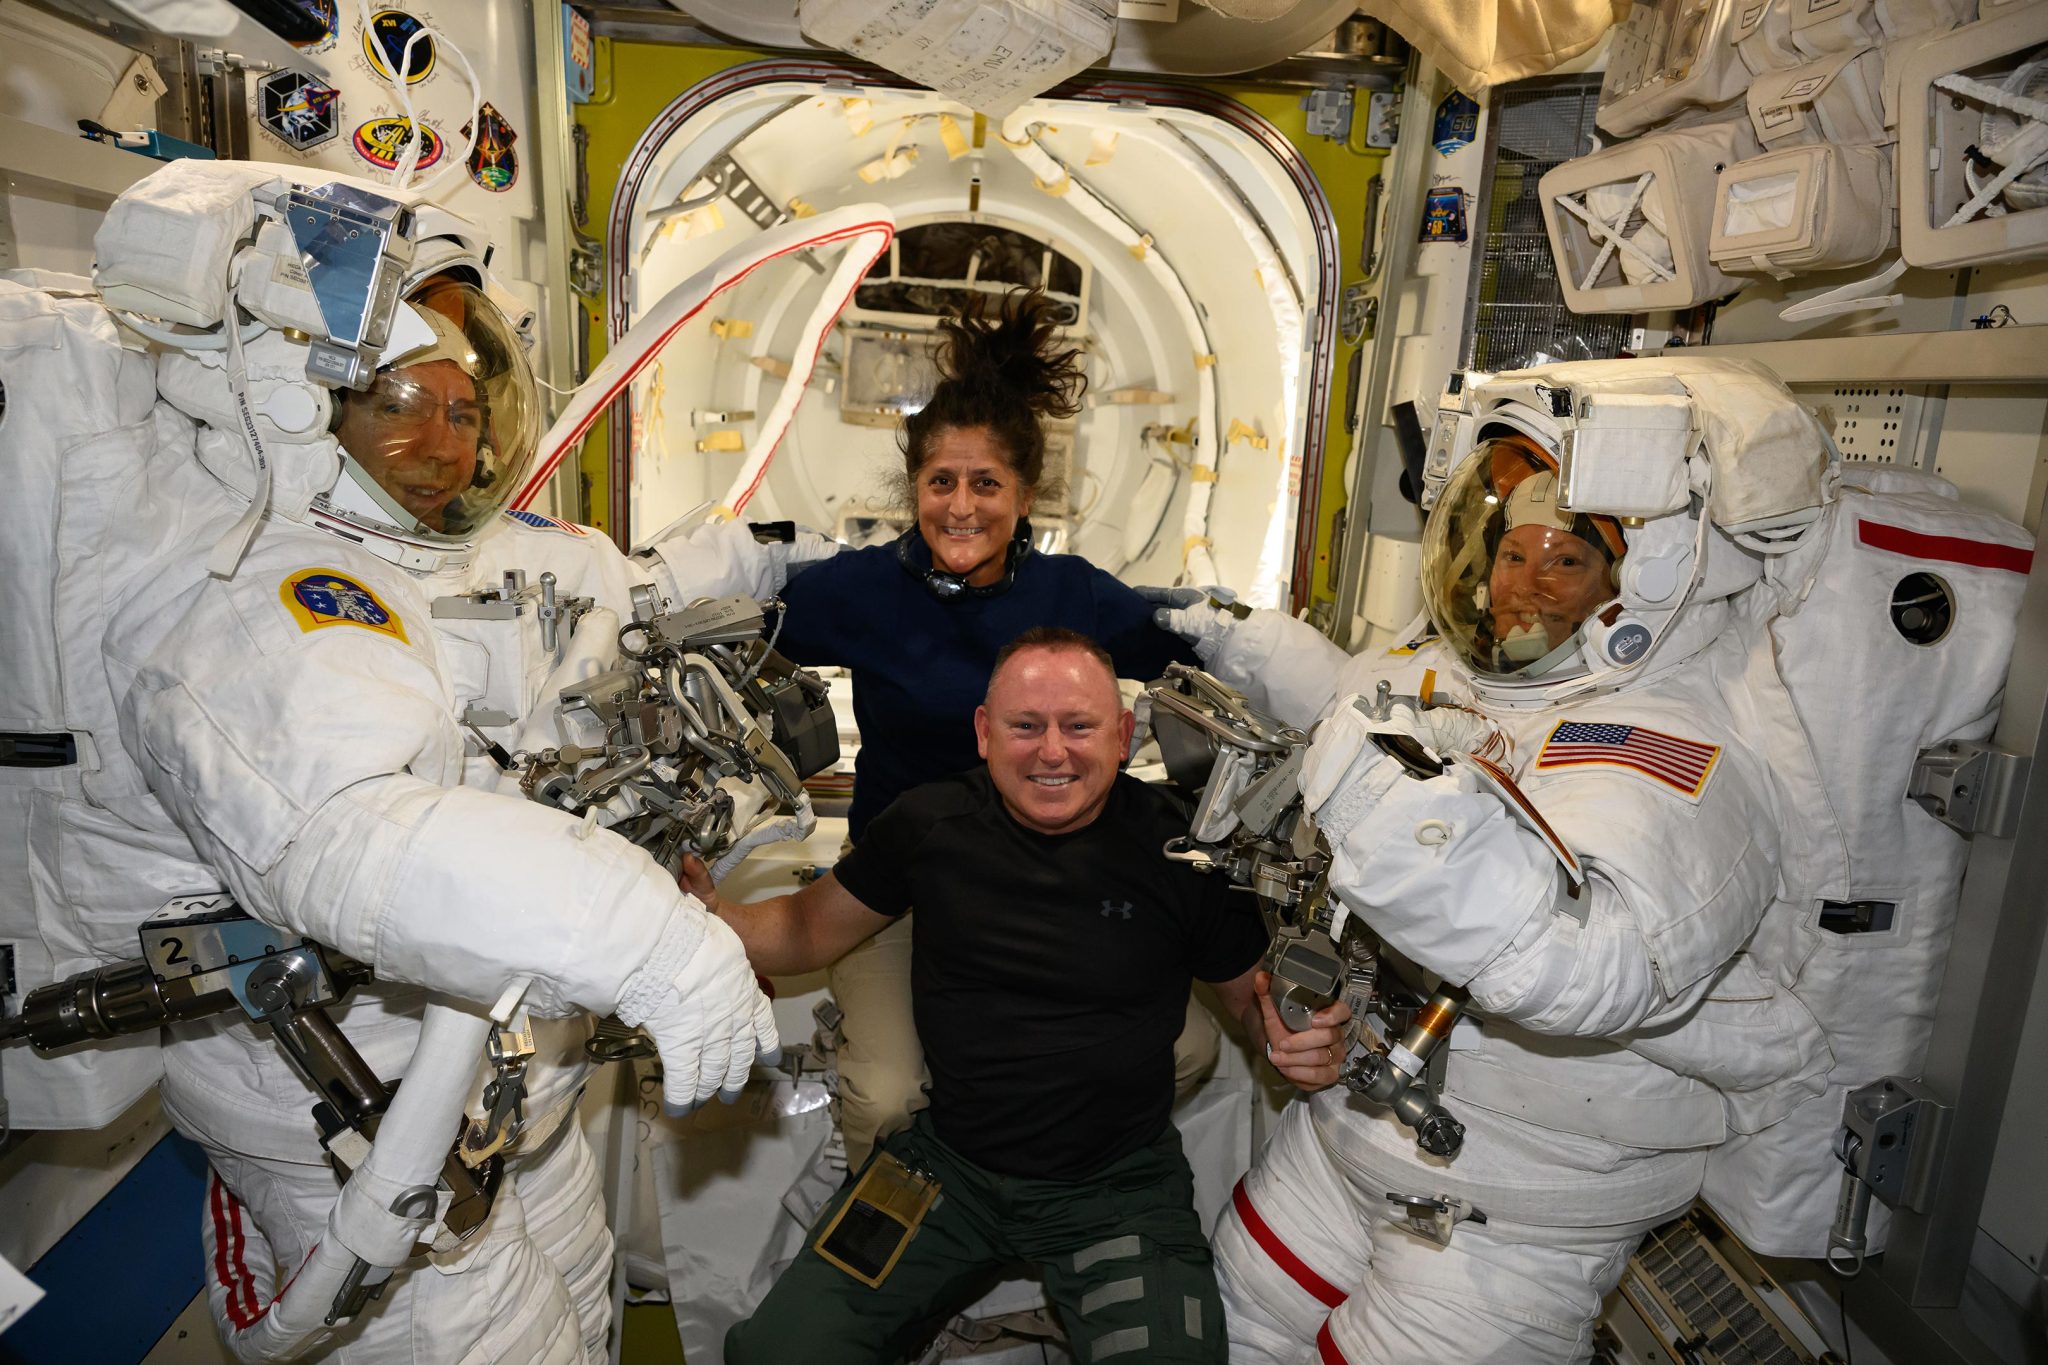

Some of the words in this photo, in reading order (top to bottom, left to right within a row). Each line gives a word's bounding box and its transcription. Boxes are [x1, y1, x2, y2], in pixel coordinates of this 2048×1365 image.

[382, 19, 397, 27] XVI
[983, 45, 1013, 71] EMU
[161, 937, 188, 965] 2
